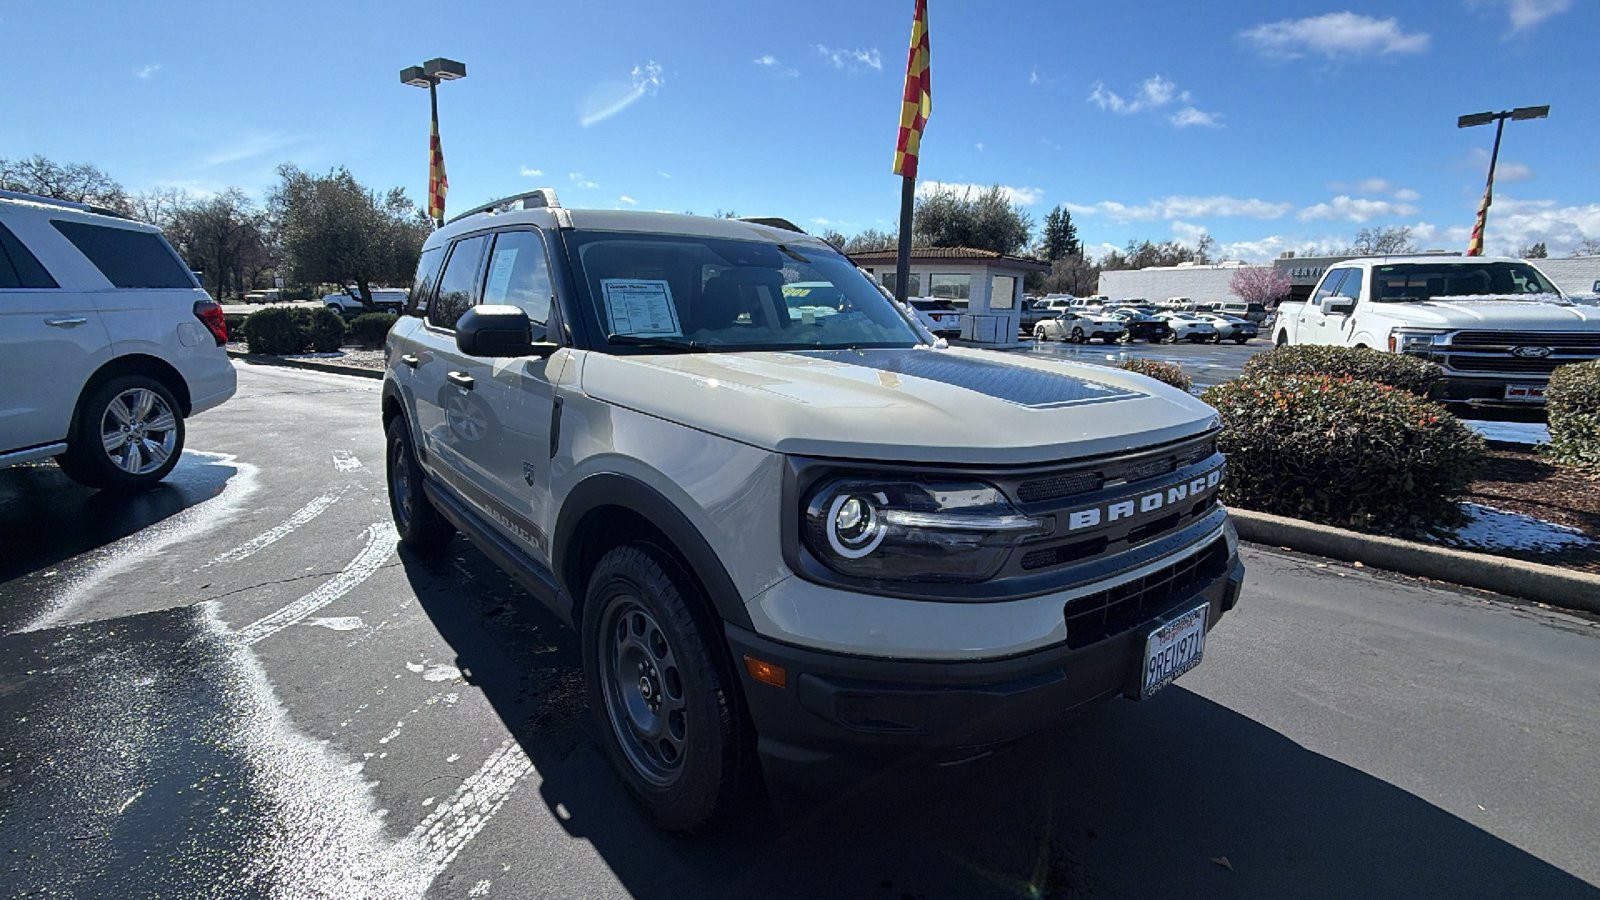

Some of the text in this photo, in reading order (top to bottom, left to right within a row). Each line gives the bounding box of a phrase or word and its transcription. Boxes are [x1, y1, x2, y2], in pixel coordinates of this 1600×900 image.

[1519, 346, 1544, 357] Ford
[1069, 469, 1220, 531] BRONCO
[1148, 629, 1200, 687] 9REU971
